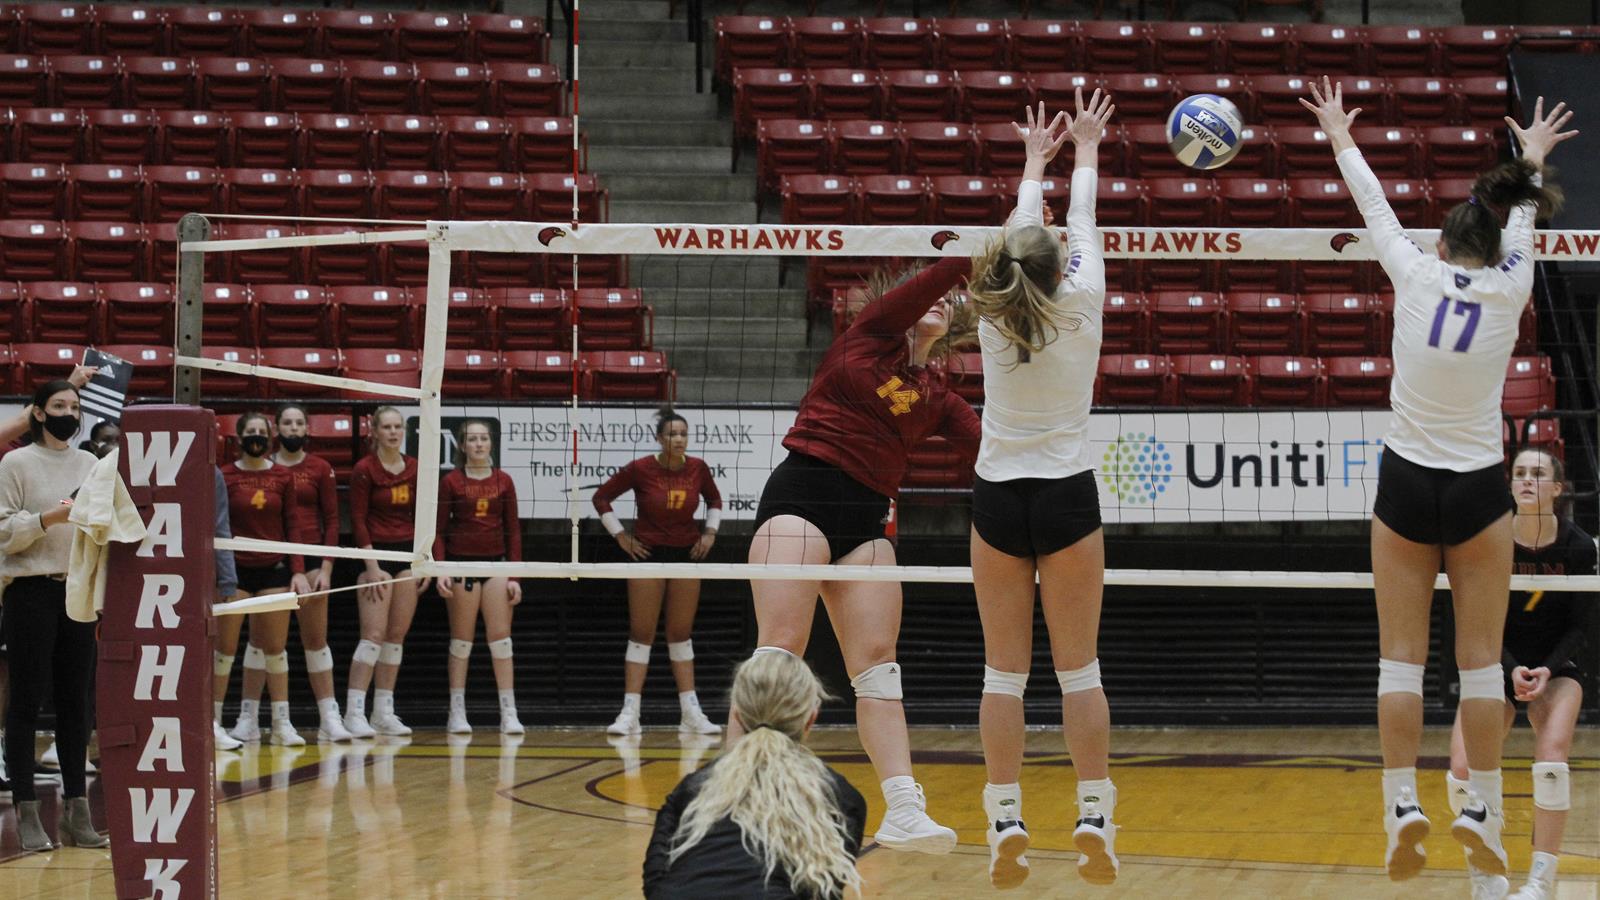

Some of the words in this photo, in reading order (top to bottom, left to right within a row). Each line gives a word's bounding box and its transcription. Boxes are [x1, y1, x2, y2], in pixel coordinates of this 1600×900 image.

[1186, 120, 1223, 150] molten
[654, 228, 845, 251] WARHAWKS
[1102, 231, 1243, 253] RHAWKS
[1533, 233, 1600, 255] HAW
[1428, 296, 1482, 352] 17
[875, 375, 920, 417] 14
[508, 422, 571, 443] FIRST
[579, 423, 659, 444] NATION
[695, 424, 754, 444] BANK
[530, 461, 564, 477] The
[570, 462, 619, 477] Unco
[1186, 440, 1325, 488] Uniti
[1343, 439, 1384, 488] Fi
[250, 489, 267, 510] 4
[391, 483, 409, 504] 18
[667, 490, 687, 509] 17
[475, 498, 489, 517] 9
[729, 500, 756, 511] FDIC
